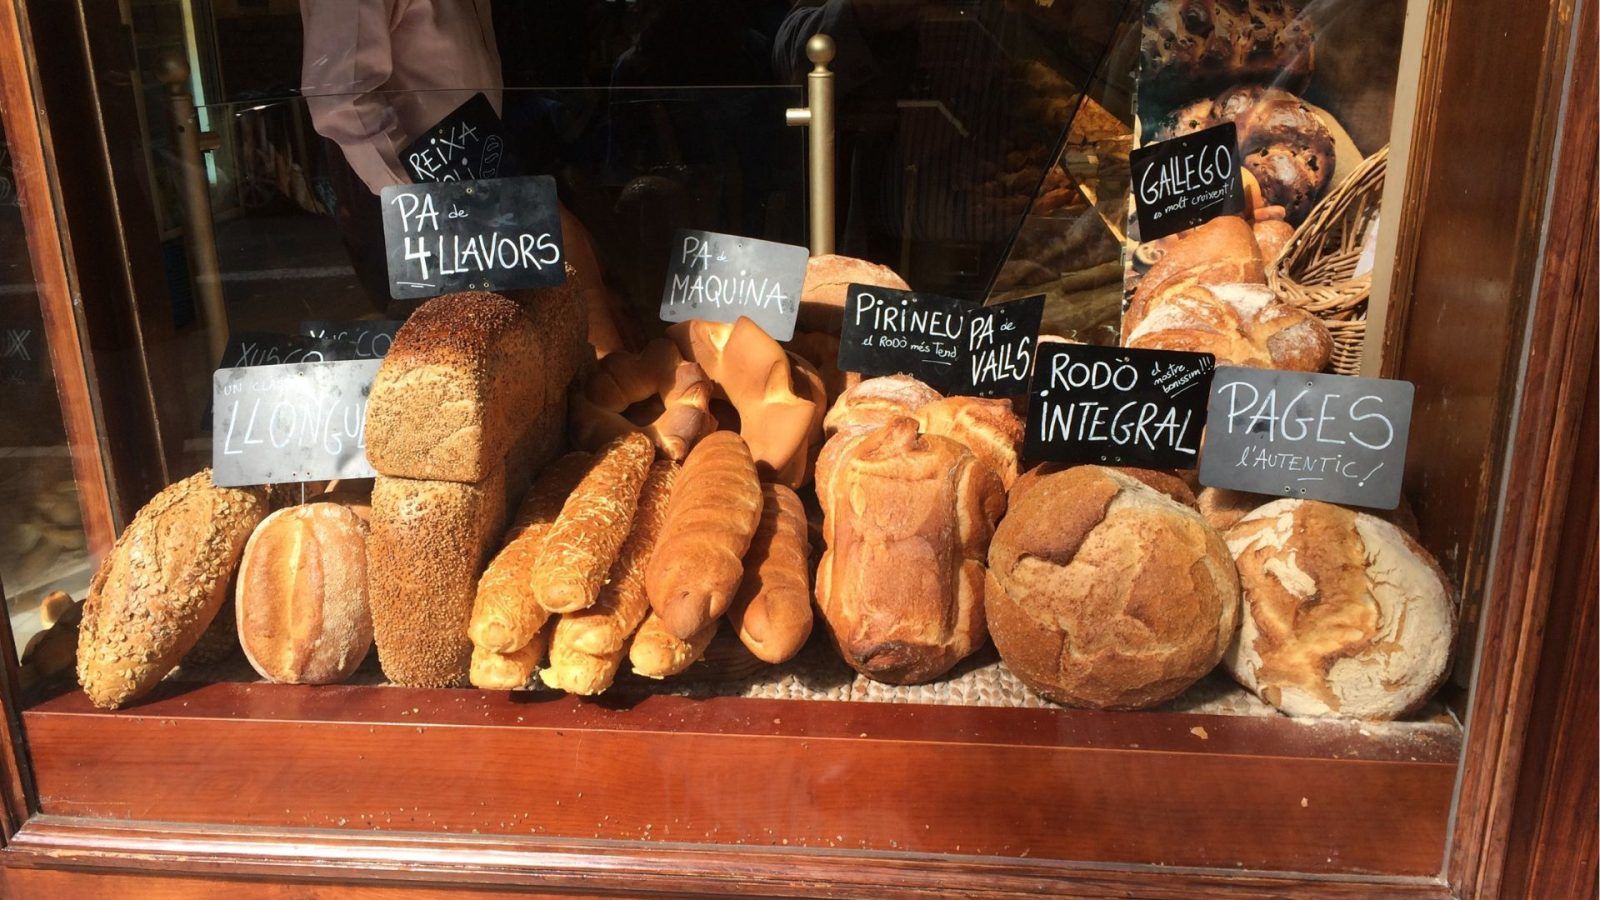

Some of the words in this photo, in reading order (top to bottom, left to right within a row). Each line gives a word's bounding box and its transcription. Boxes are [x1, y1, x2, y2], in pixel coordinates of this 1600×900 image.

[1140, 144, 1232, 205] GALLEGO
[391, 193, 439, 232] PA
[448, 204, 469, 219] de
[404, 236, 431, 280] 4
[439, 232, 560, 275] LLAVORS
[682, 236, 712, 270] PA
[716, 250, 728, 262] de
[969, 314, 995, 351] PA
[1000, 317, 1016, 331] de
[971, 336, 1030, 386] VALLS
[1151, 361, 1162, 376] el
[1217, 381, 1394, 450] PAGES
